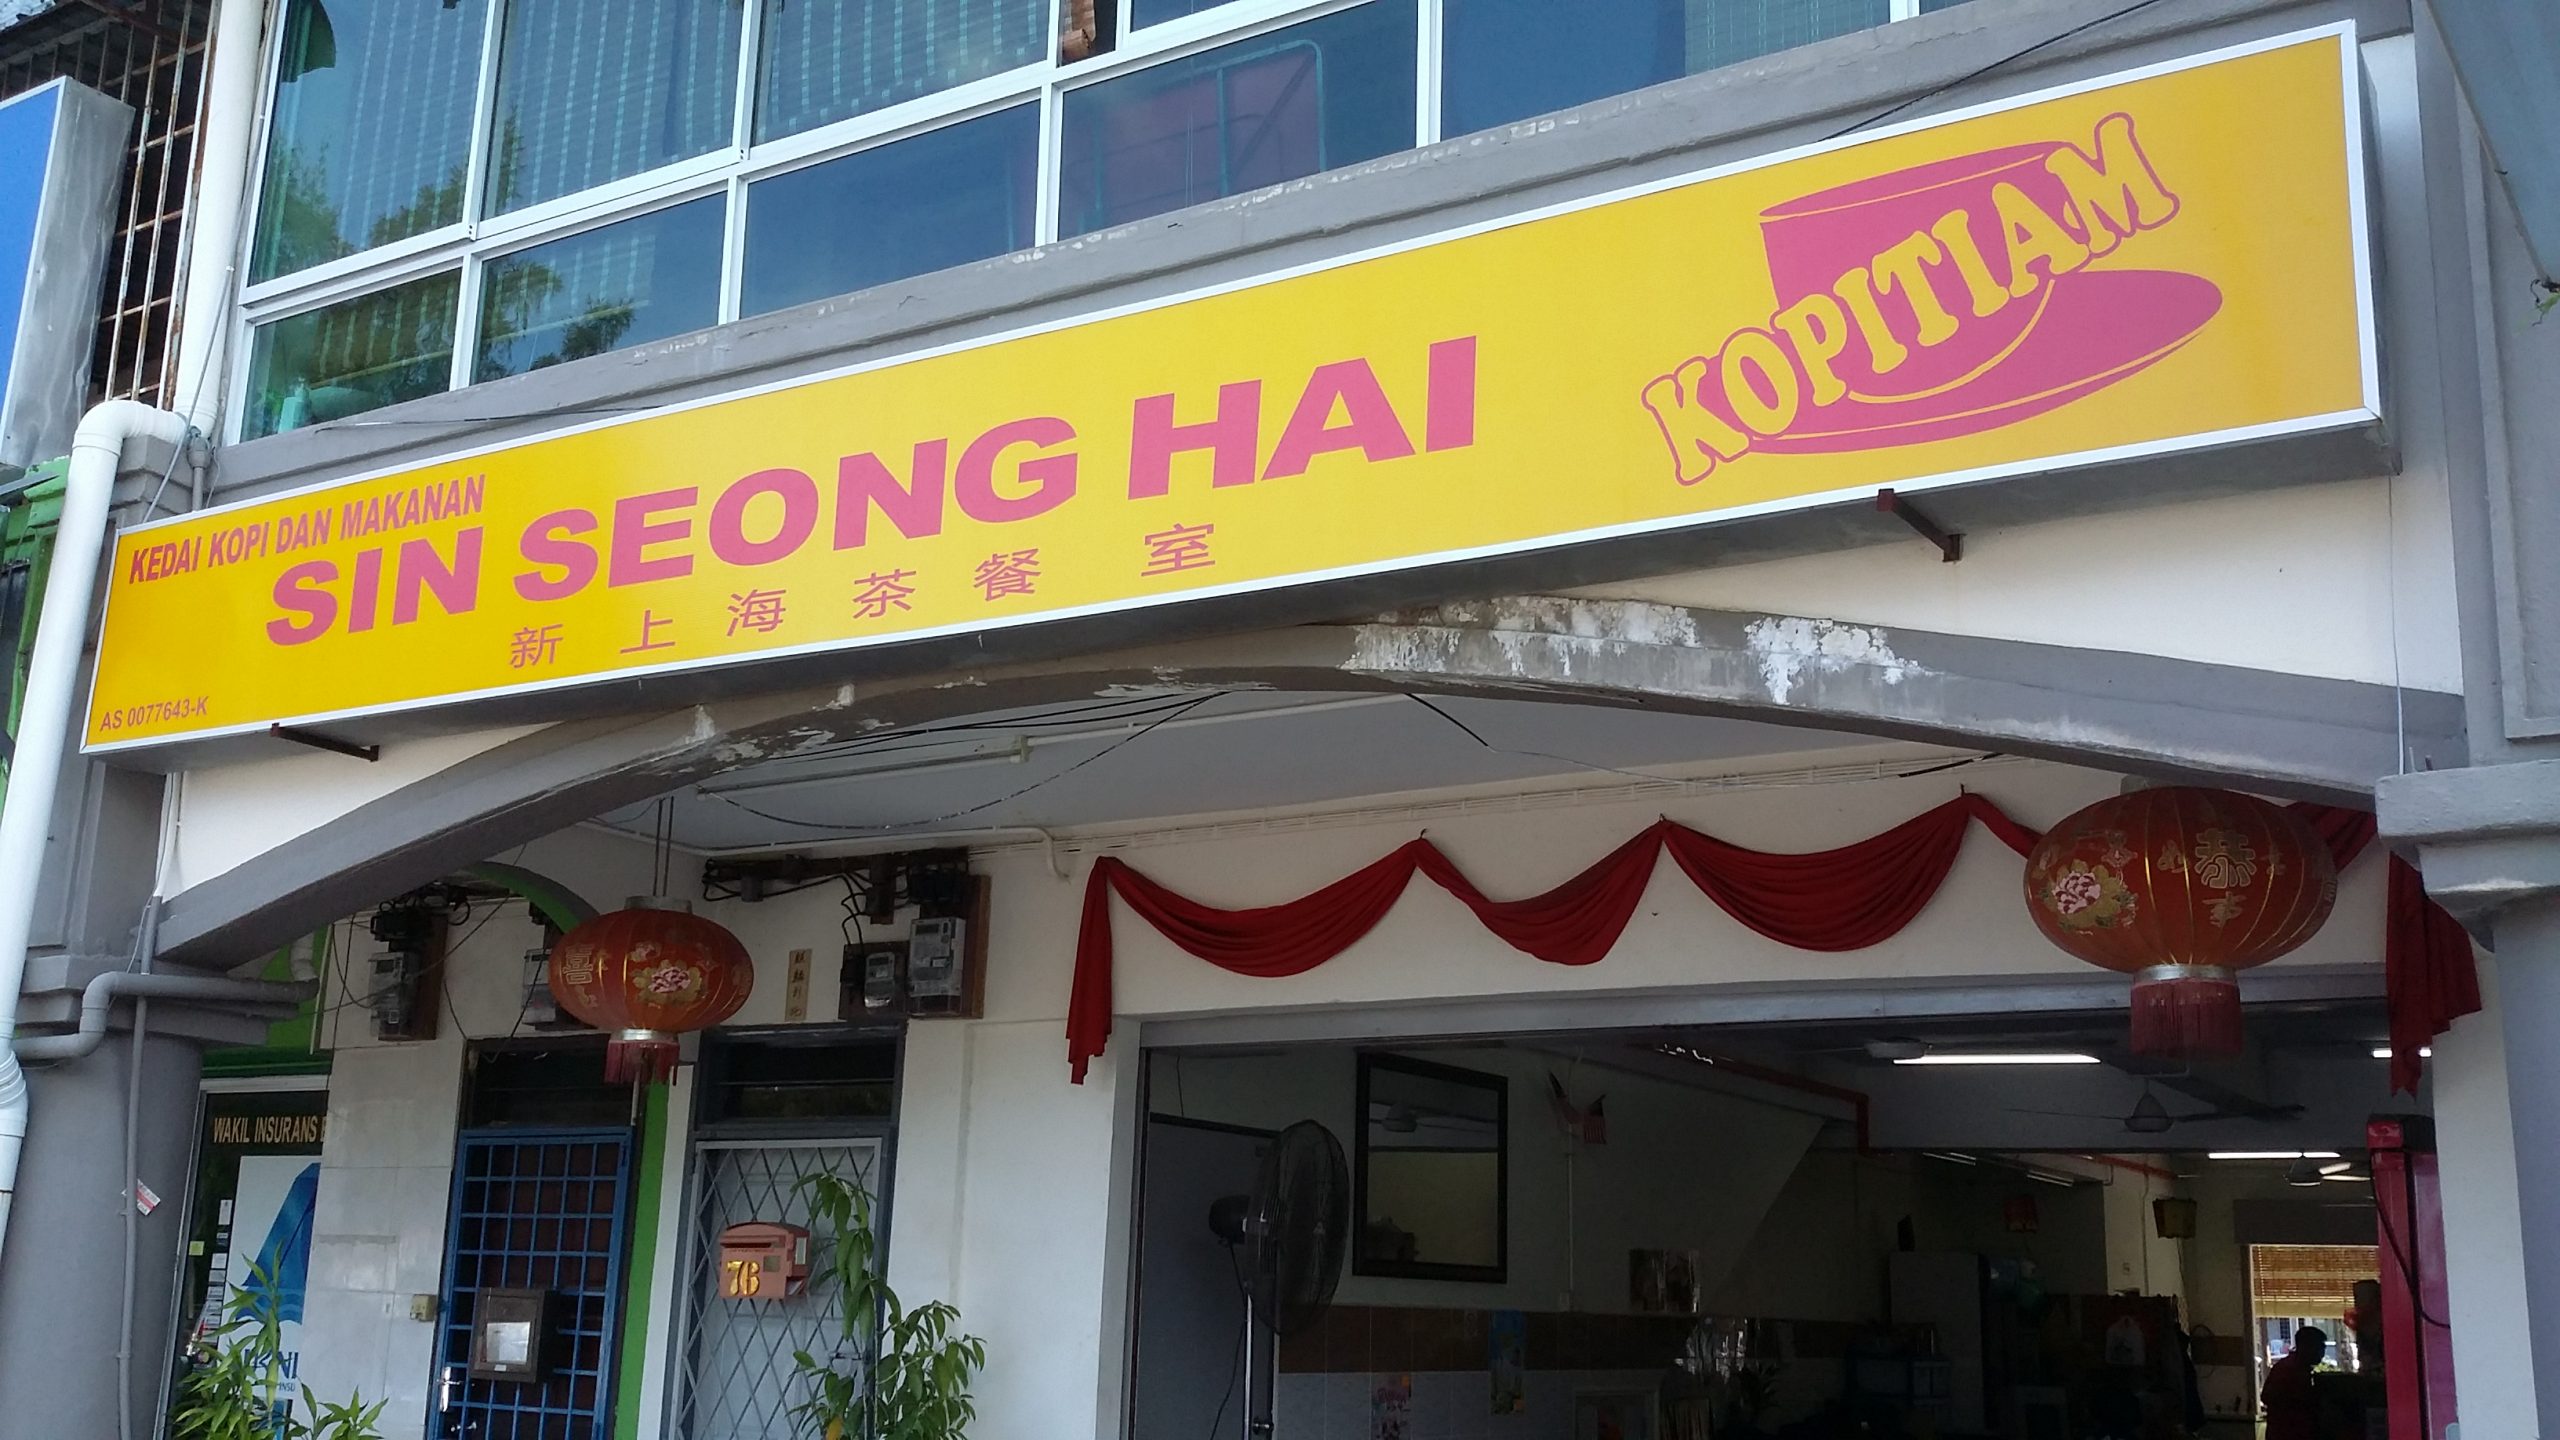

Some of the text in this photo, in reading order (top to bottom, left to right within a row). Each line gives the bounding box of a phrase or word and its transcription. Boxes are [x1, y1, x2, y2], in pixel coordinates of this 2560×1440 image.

[1641, 112, 2181, 487] KOPITIAM
[128, 474, 486, 585] KEDAI KOPI DAN MAKANAN
[266, 335, 1478, 646] SIN SEONG HAI
[508, 521, 1217, 670] 新上海茶餐室
[100, 695, 209, 732] AS 0077643-K
[213, 1115, 250, 1144] WAKIL
[254, 1114, 319, 1144] INSURANS
[727, 1260, 761, 1296] 76
